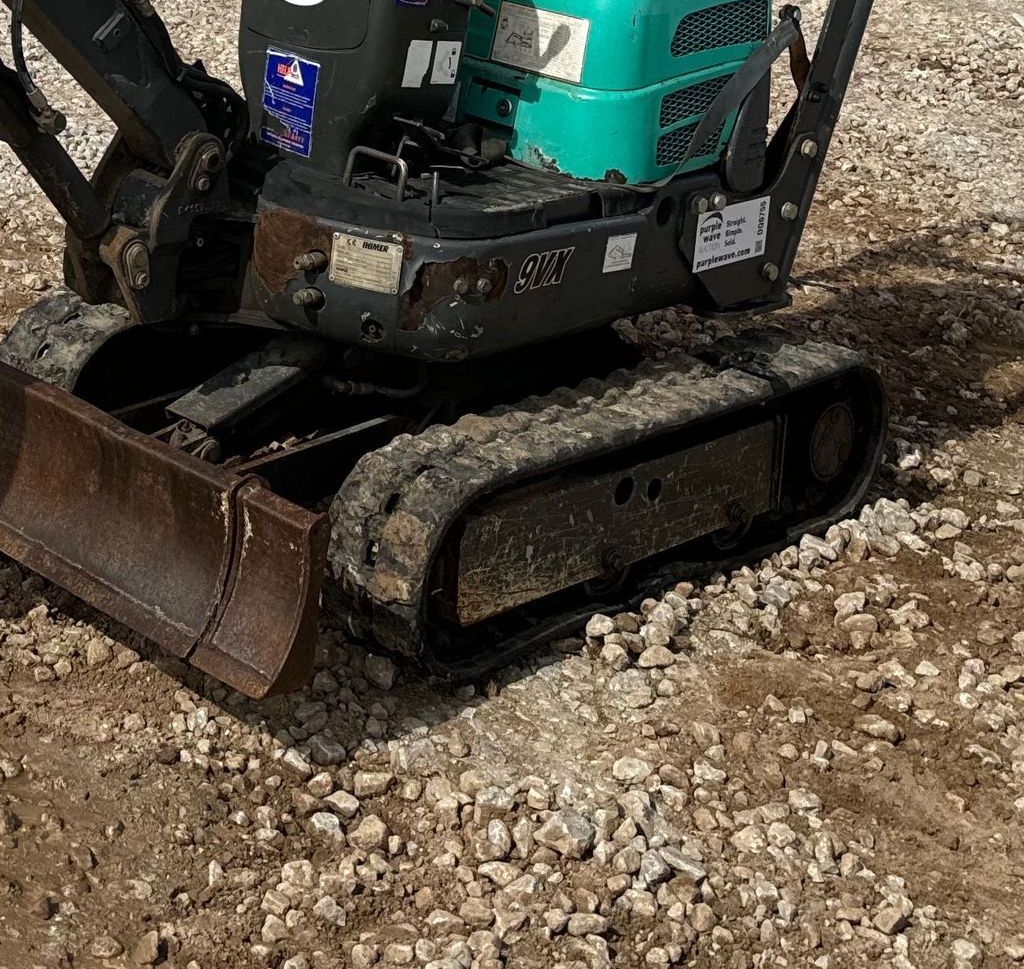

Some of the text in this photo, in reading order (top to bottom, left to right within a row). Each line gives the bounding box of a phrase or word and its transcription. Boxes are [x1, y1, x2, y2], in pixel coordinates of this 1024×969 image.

[700, 221, 722, 236] purple
[703, 232, 721, 243] wave
[696, 248, 751, 270] purplewave.com
[514, 246, 575, 294] 9VX
